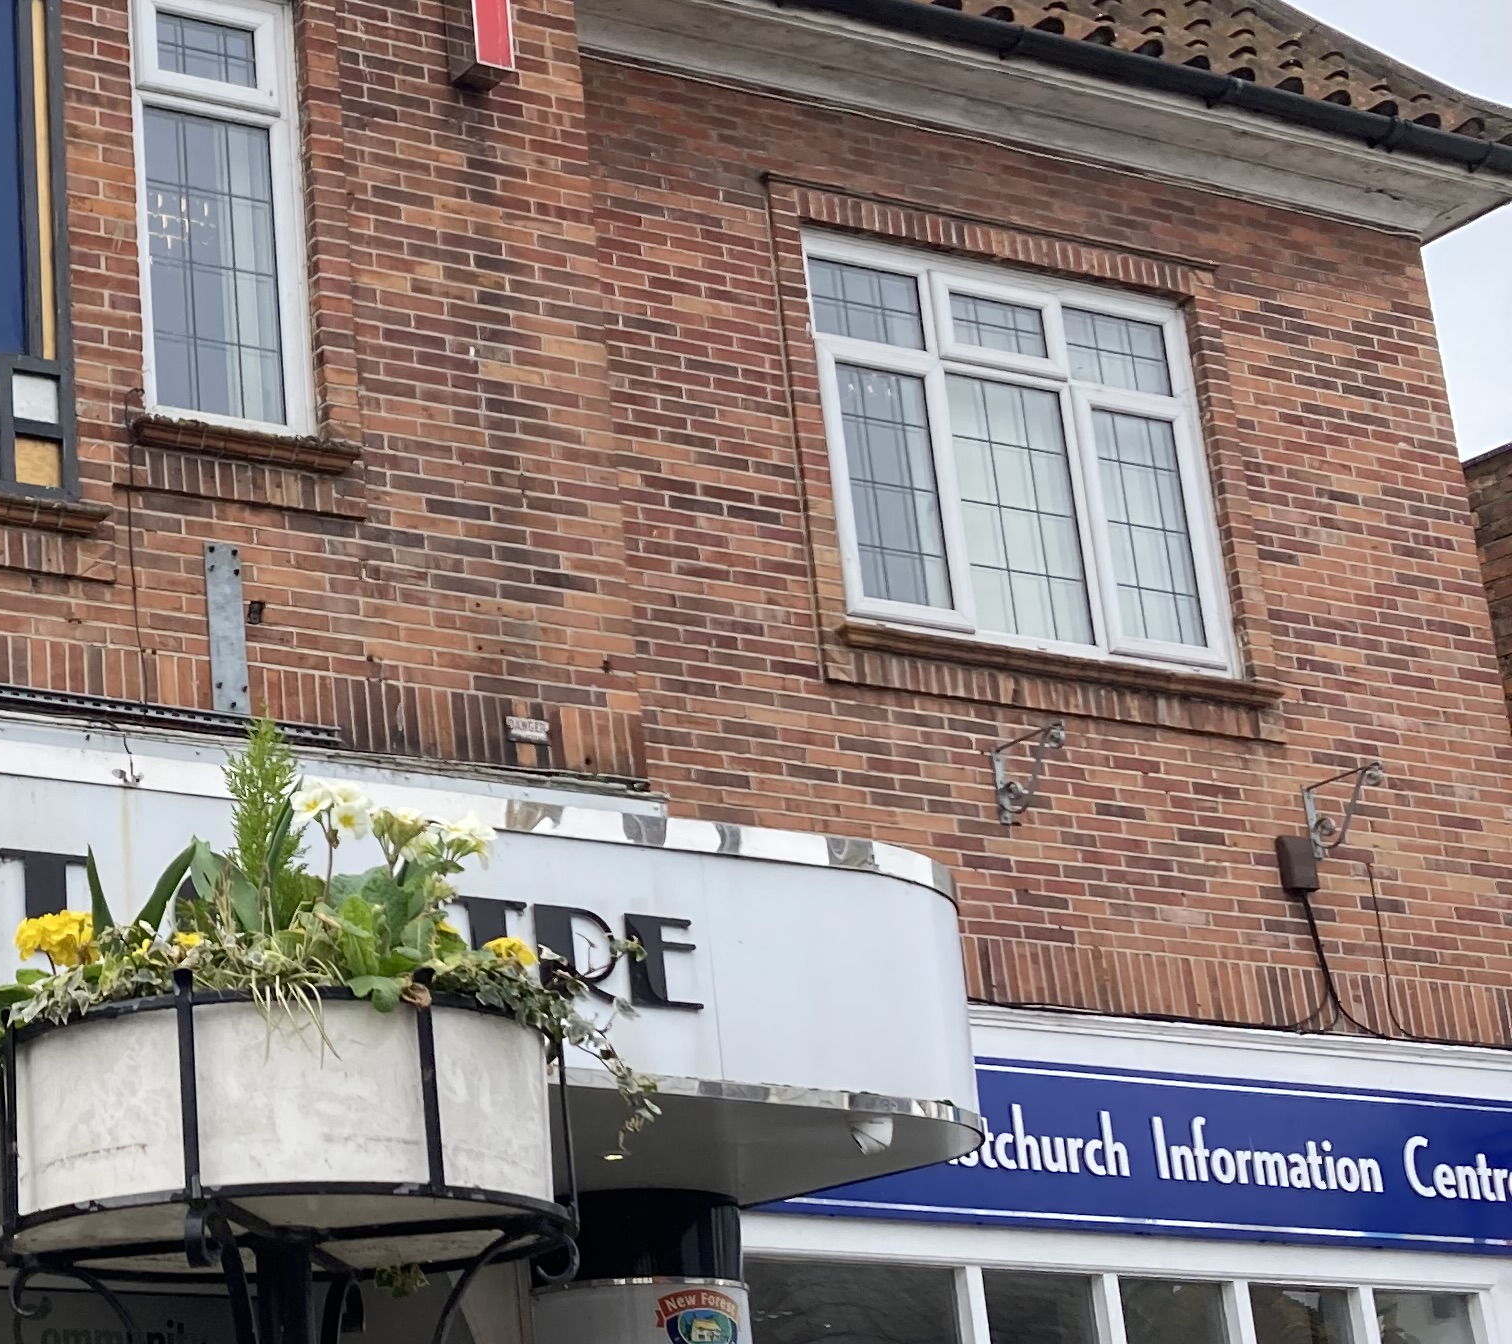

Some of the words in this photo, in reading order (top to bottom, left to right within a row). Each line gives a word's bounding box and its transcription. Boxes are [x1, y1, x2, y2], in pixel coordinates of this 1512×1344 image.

[1150, 1115, 1384, 1193] Information
[1402, 1135, 1512, 1202] Centr
[664, 1295, 696, 1312] New
[700, 1292, 736, 1317] Forest
